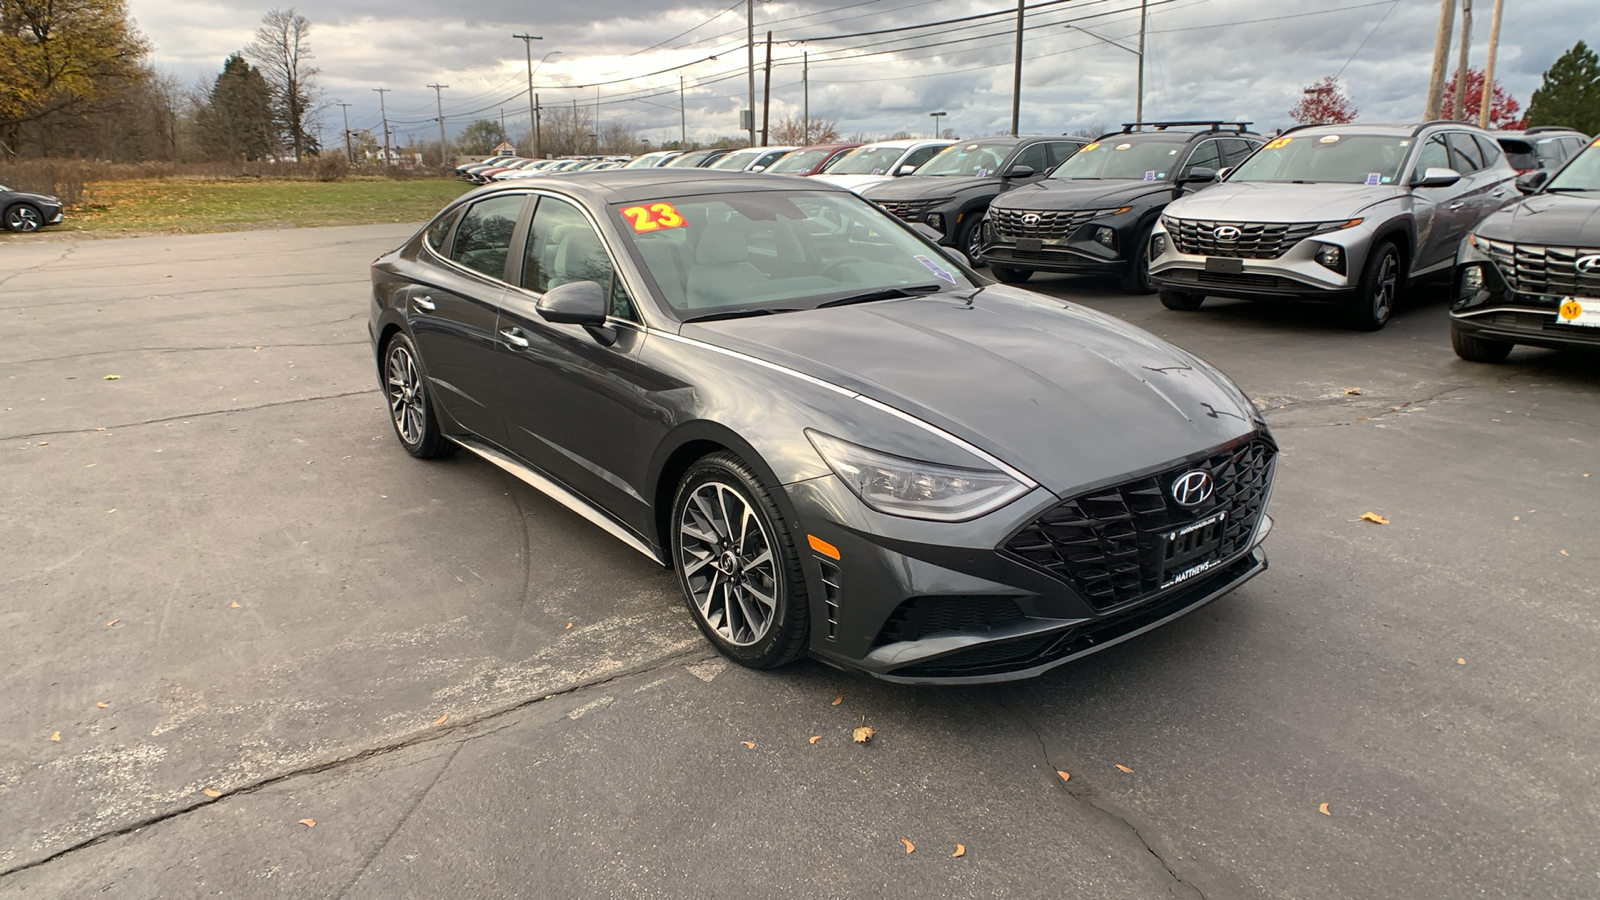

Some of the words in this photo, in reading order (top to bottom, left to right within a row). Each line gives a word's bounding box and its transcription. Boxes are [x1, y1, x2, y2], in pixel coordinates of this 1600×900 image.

[623, 203, 683, 231] 23
[1564, 305, 1578, 315] M
[1175, 561, 1209, 583] MATTHEWS
